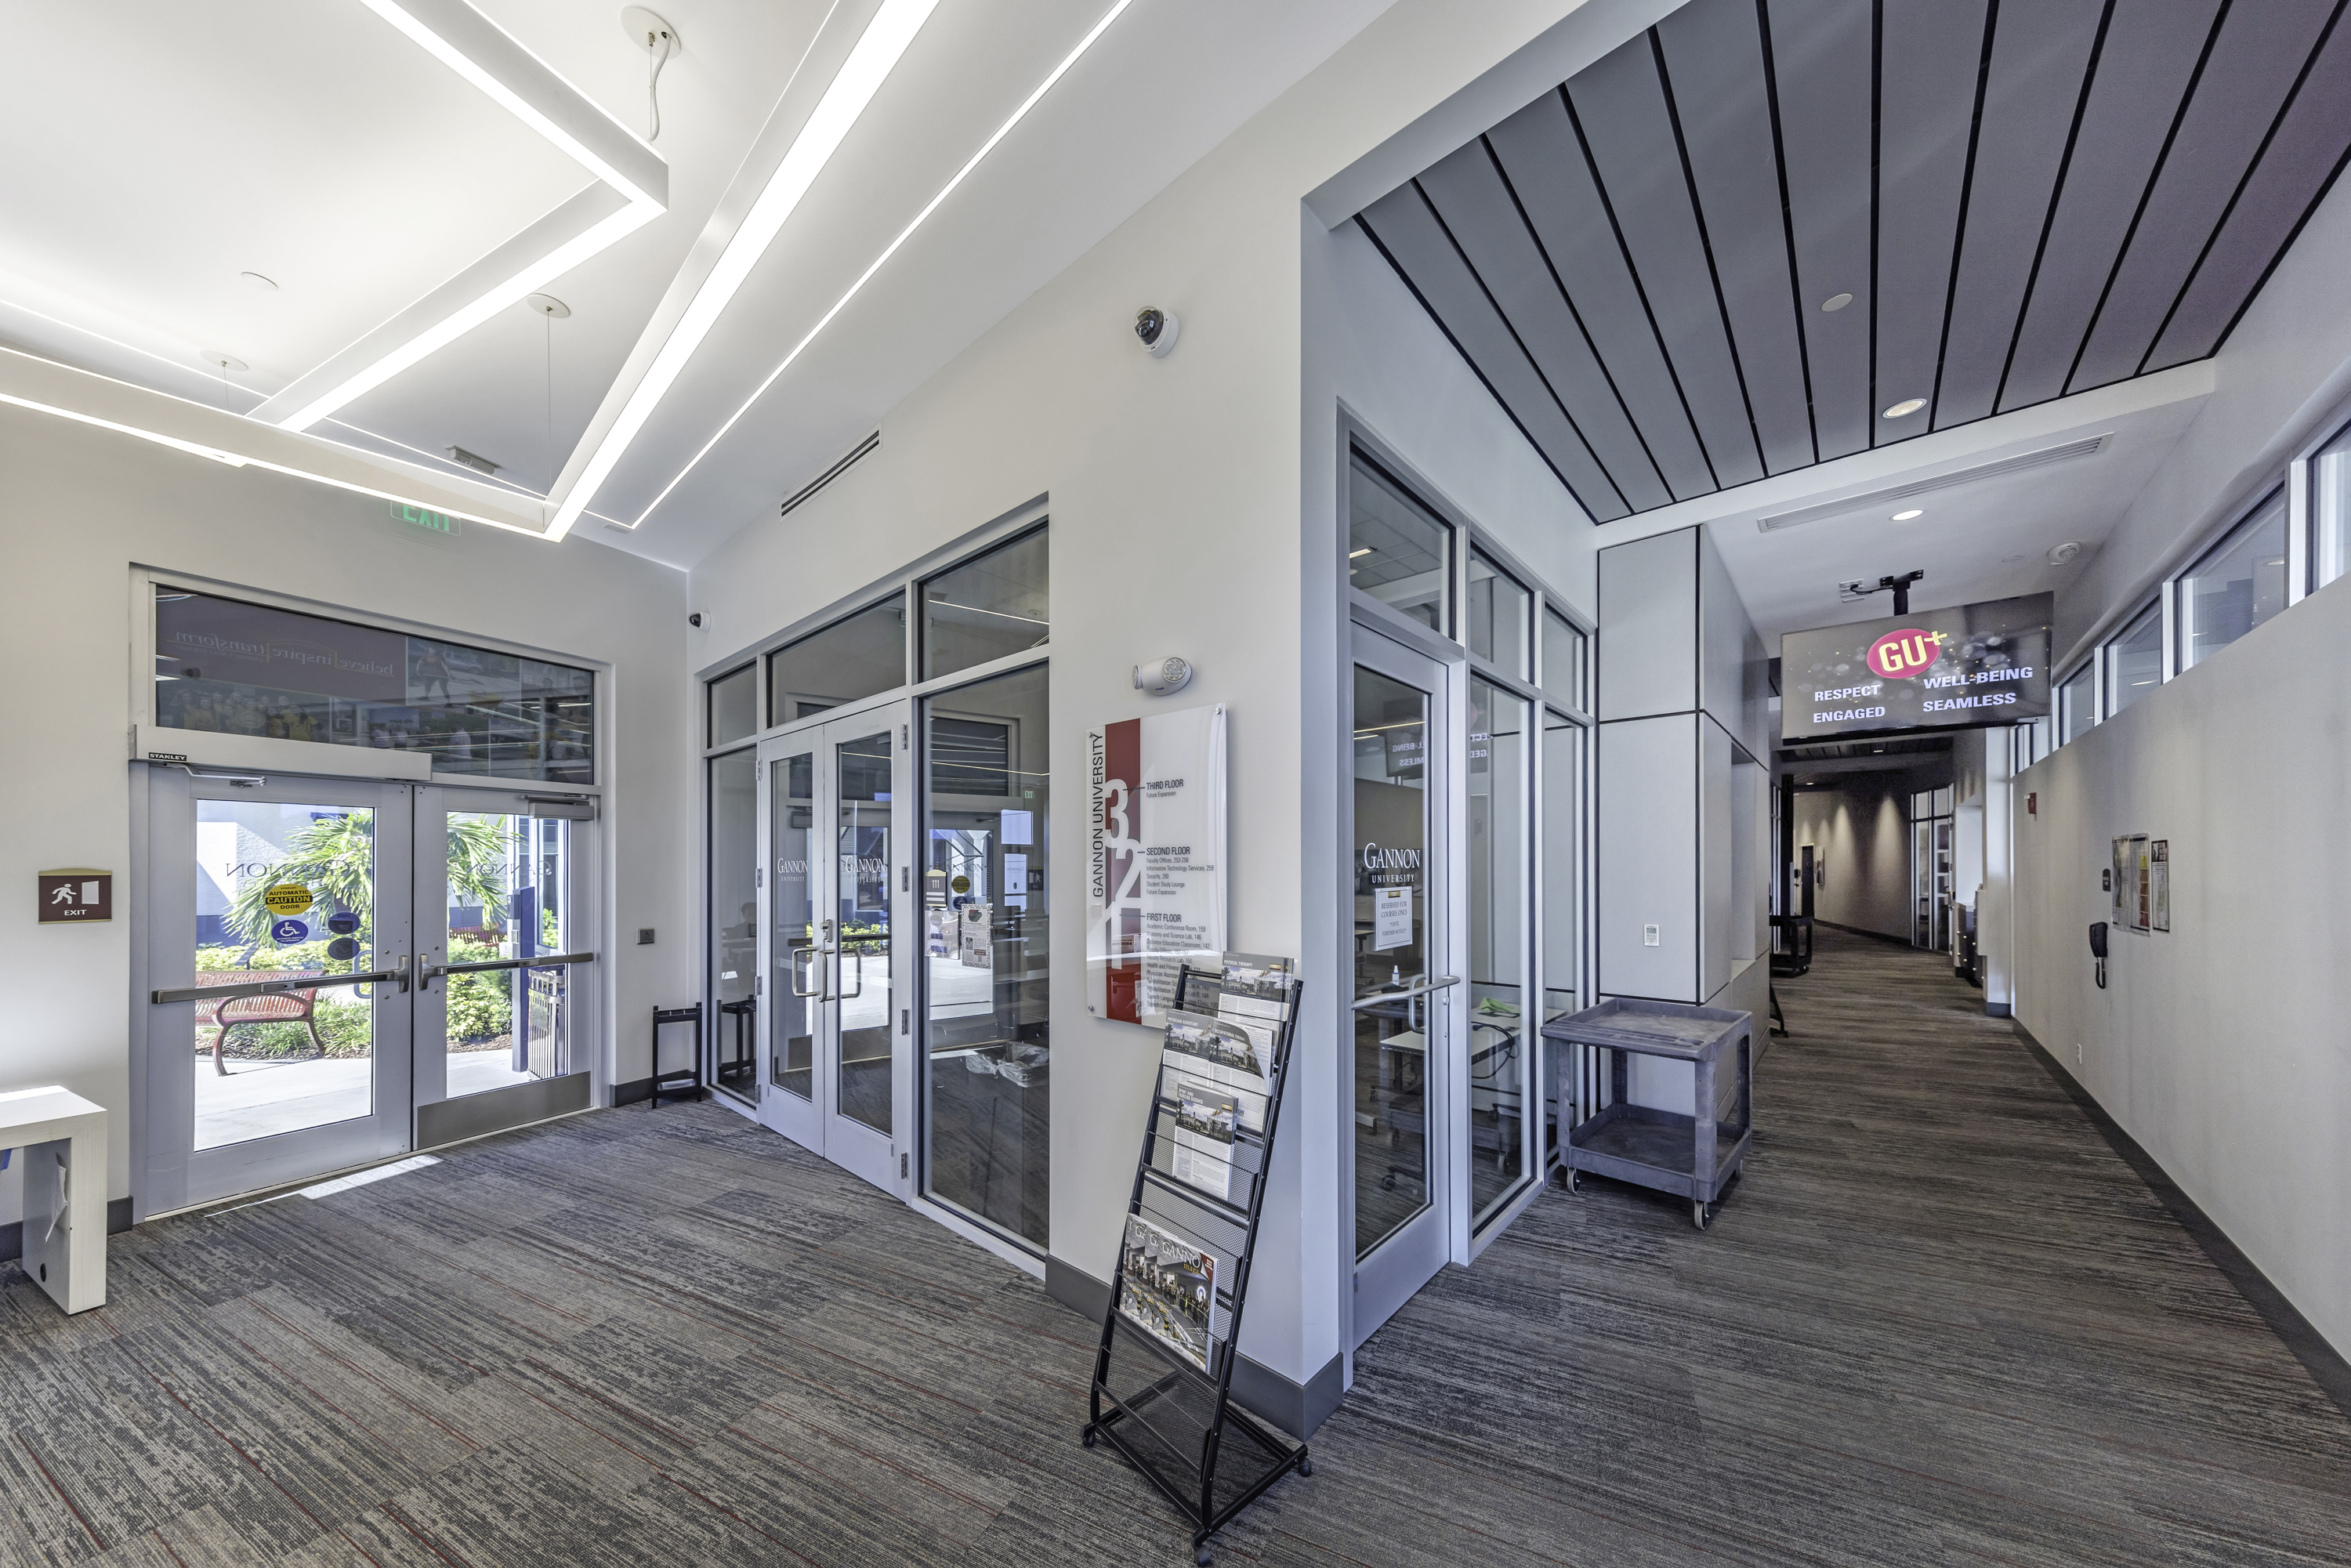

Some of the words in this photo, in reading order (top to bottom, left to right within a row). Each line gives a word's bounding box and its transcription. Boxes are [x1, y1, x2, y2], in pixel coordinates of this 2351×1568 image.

[1923, 666, 2033, 690] WELL-BEING
[1814, 684, 1881, 701] RESPECT
[1922, 692, 2016, 712] SEAMLESS
[1813, 706, 1886, 723] ENGAGED
[1092, 733, 1103, 824] UNIVERSITY
[1147, 780, 1164, 790] THIRD
[1165, 779, 1183, 788] FLOOR
[1147, 847, 1170, 856] SECOND
[1171, 846, 1190, 855] FLOOR
[1364, 842, 1421, 869] GANNON
[777, 857, 809, 874] GANNON
[846, 856, 886, 874] GANNON
[1092, 829, 1103, 898] GANNON
[931, 879, 940, 889] 111
[1371, 874, 1415, 884] UNIVERSITY
[267, 896, 310, 904] CAUTION
[1147, 913, 1162, 922] FIRST
[1163, 914, 1182, 922] FLOOR
[1215, 1028, 1234, 1038] OCCUPATIONAL
[1178, 1092, 1190, 1101] EXERCISE
[1162, 1242, 1201, 1269] GANNO
